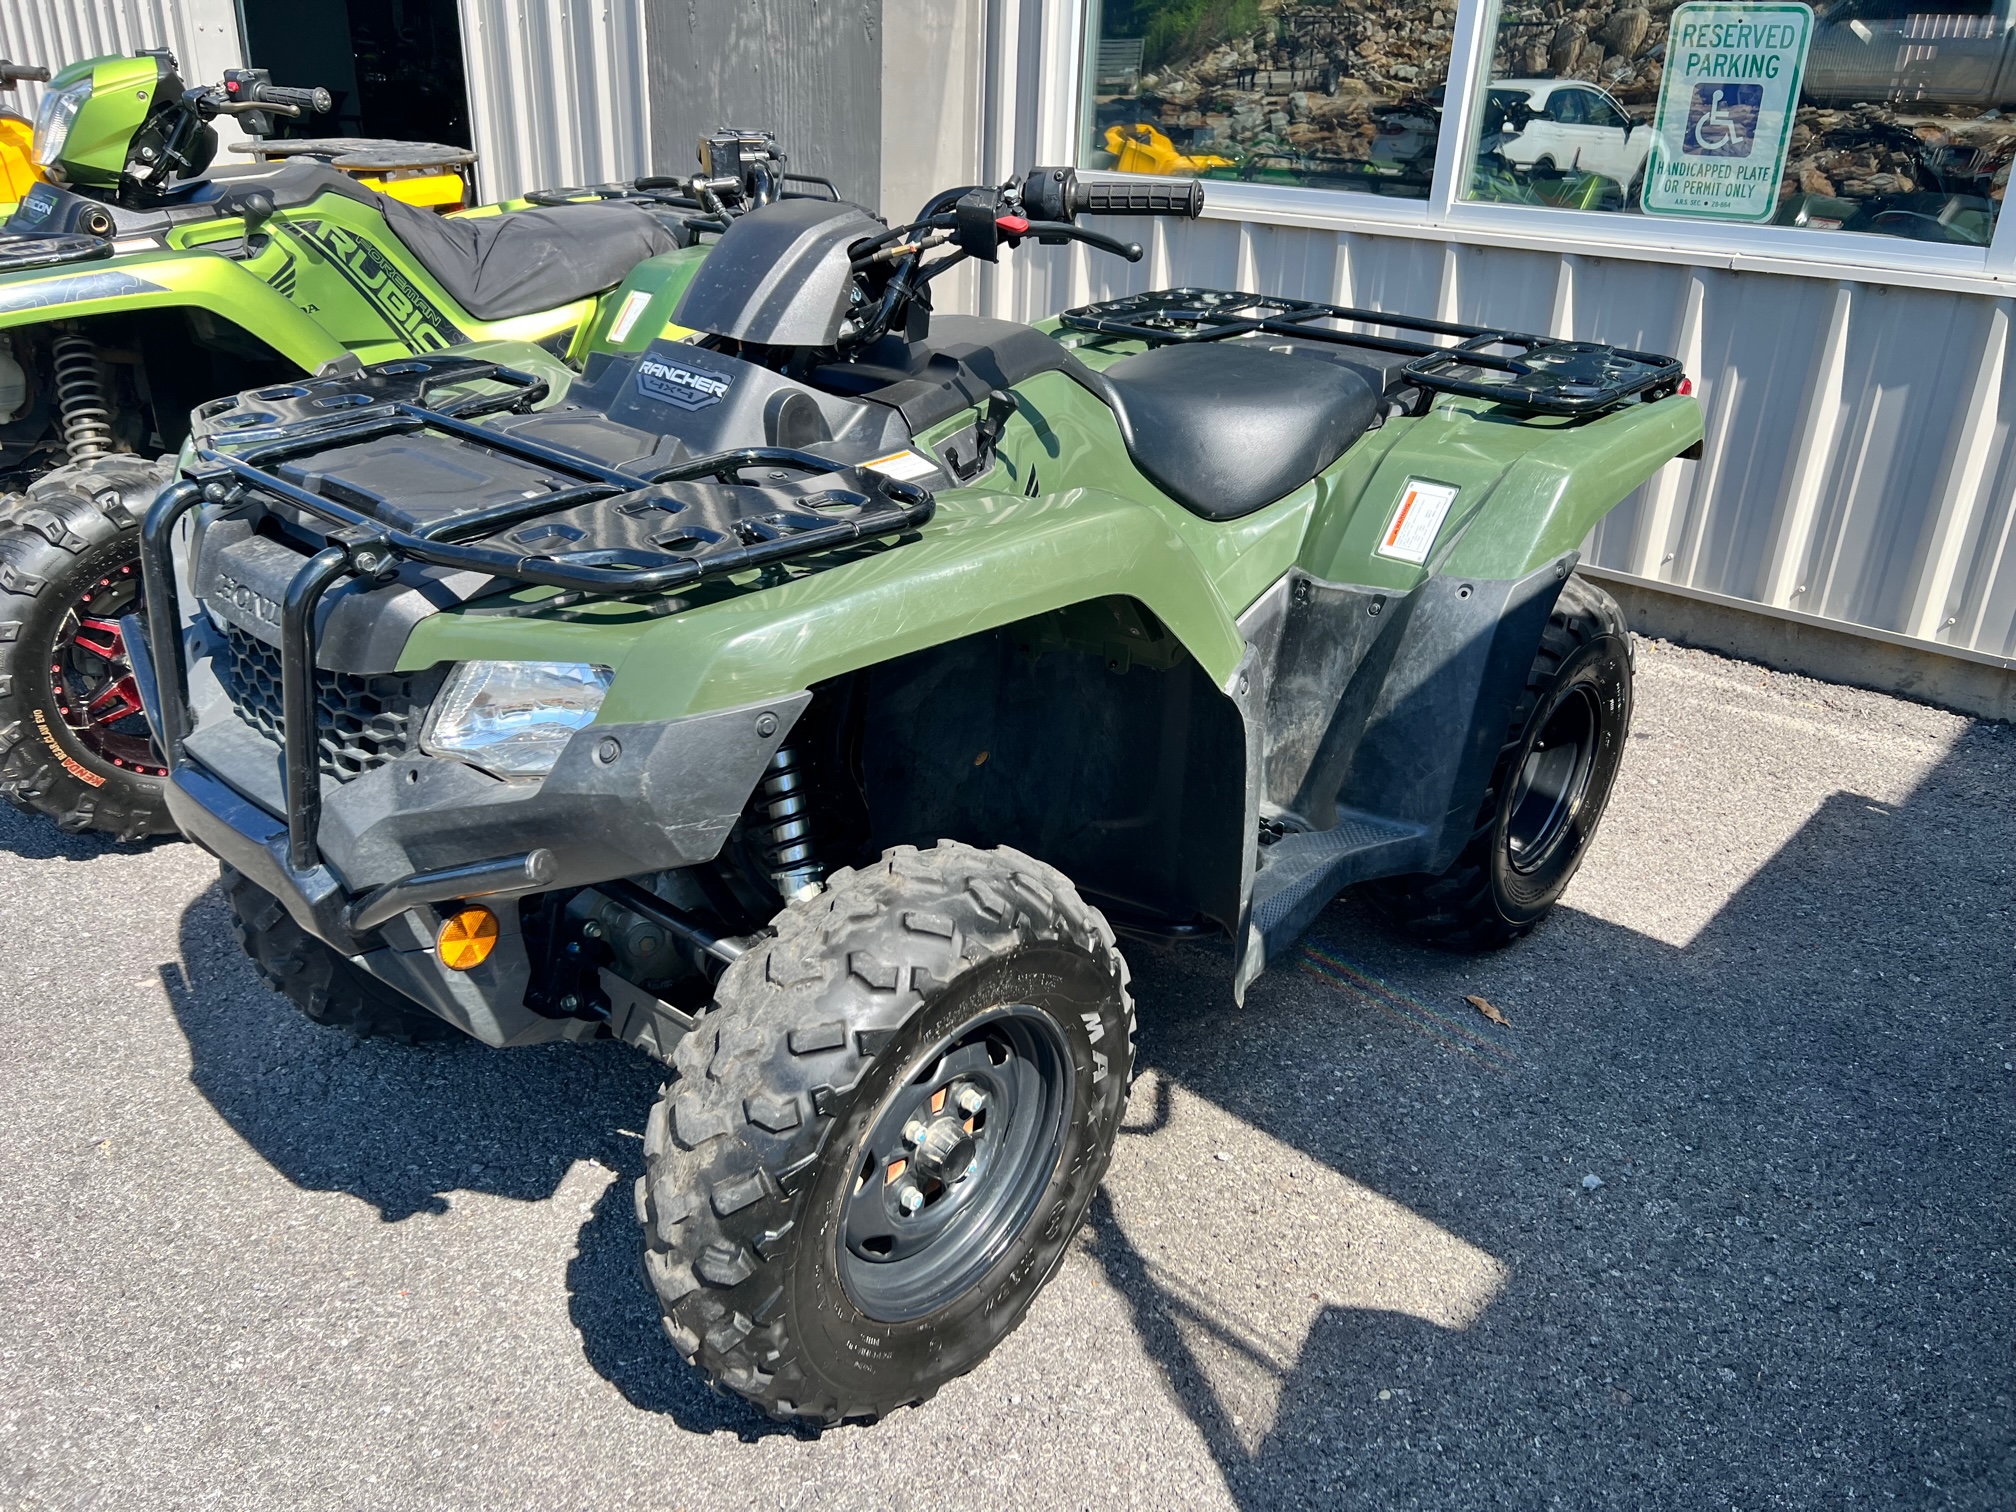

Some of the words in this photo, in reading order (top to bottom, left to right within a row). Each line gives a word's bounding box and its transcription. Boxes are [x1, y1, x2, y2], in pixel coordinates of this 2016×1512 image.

[1681, 23, 1795, 49] RESERVED
[1685, 53, 1781, 78] PARKING
[1656, 160, 1732, 179] HANDICAPPED
[1737, 165, 1771, 182] PLATE
[1664, 180, 1679, 194] OR
[1683, 180, 1721, 196] PERMIT
[1726, 183, 1756, 199] ONLY
[356, 235, 442, 327] FOREMAN
[638, 360, 729, 398] RANCHER
[33, 709, 46, 724] EVO
[61, 757, 107, 788] KENDA
